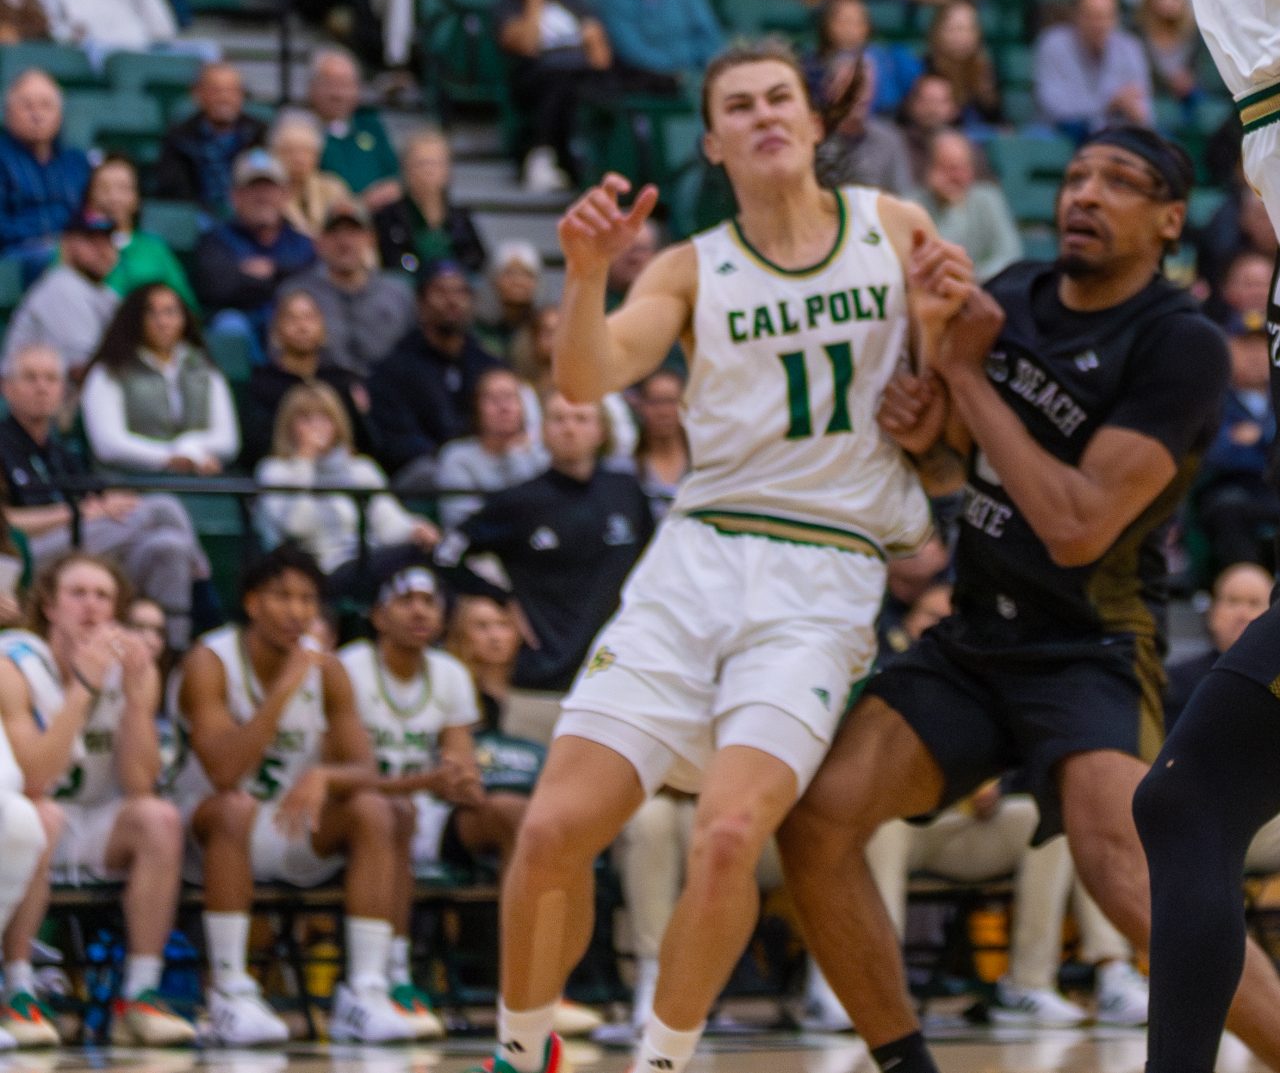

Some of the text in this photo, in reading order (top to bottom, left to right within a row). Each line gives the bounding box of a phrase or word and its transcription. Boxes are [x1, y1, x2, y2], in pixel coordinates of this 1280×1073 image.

[727, 284, 889, 345] CAL POLY
[776, 340, 856, 442] 11
[1008, 356, 1088, 439] BEACH
[963, 482, 1013, 539] ATE
